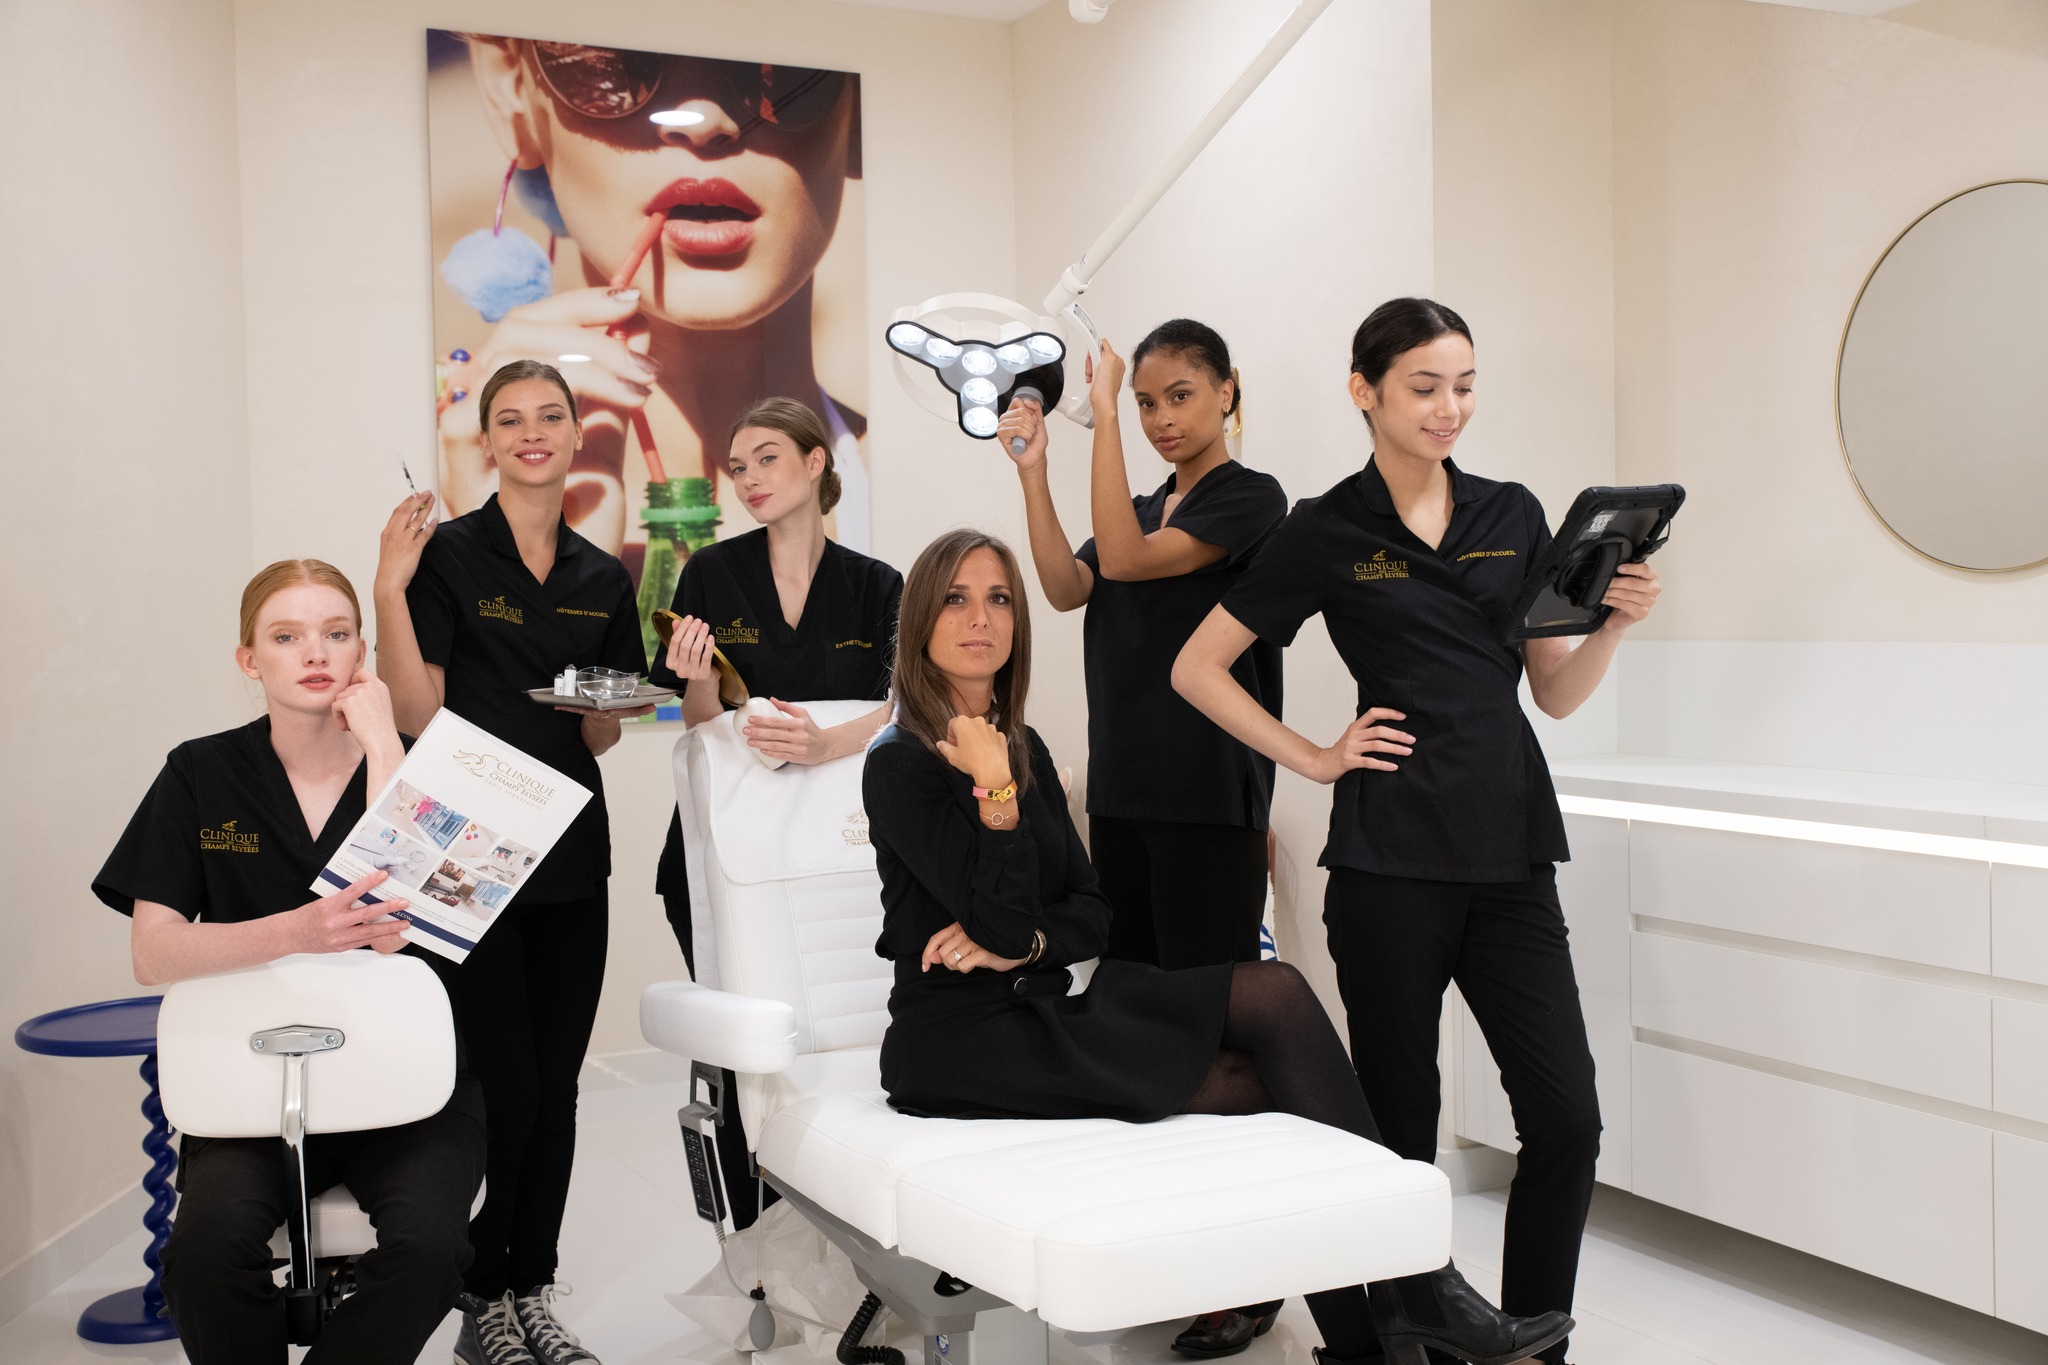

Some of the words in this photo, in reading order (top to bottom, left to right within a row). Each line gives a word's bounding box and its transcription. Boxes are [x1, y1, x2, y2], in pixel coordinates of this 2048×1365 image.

[1354, 561, 1408, 572] CLINIQUE
[478, 599, 523, 617] CLINIQUE
[715, 626, 759, 637] CLINIQUE
[490, 772, 519, 792] CHAMPS
[496, 761, 556, 797] CLINIQUE
[200, 828, 259, 845] CLINIQUE
[842, 829, 870, 839] CLIN
[200, 843, 230, 851] CHAMPS
